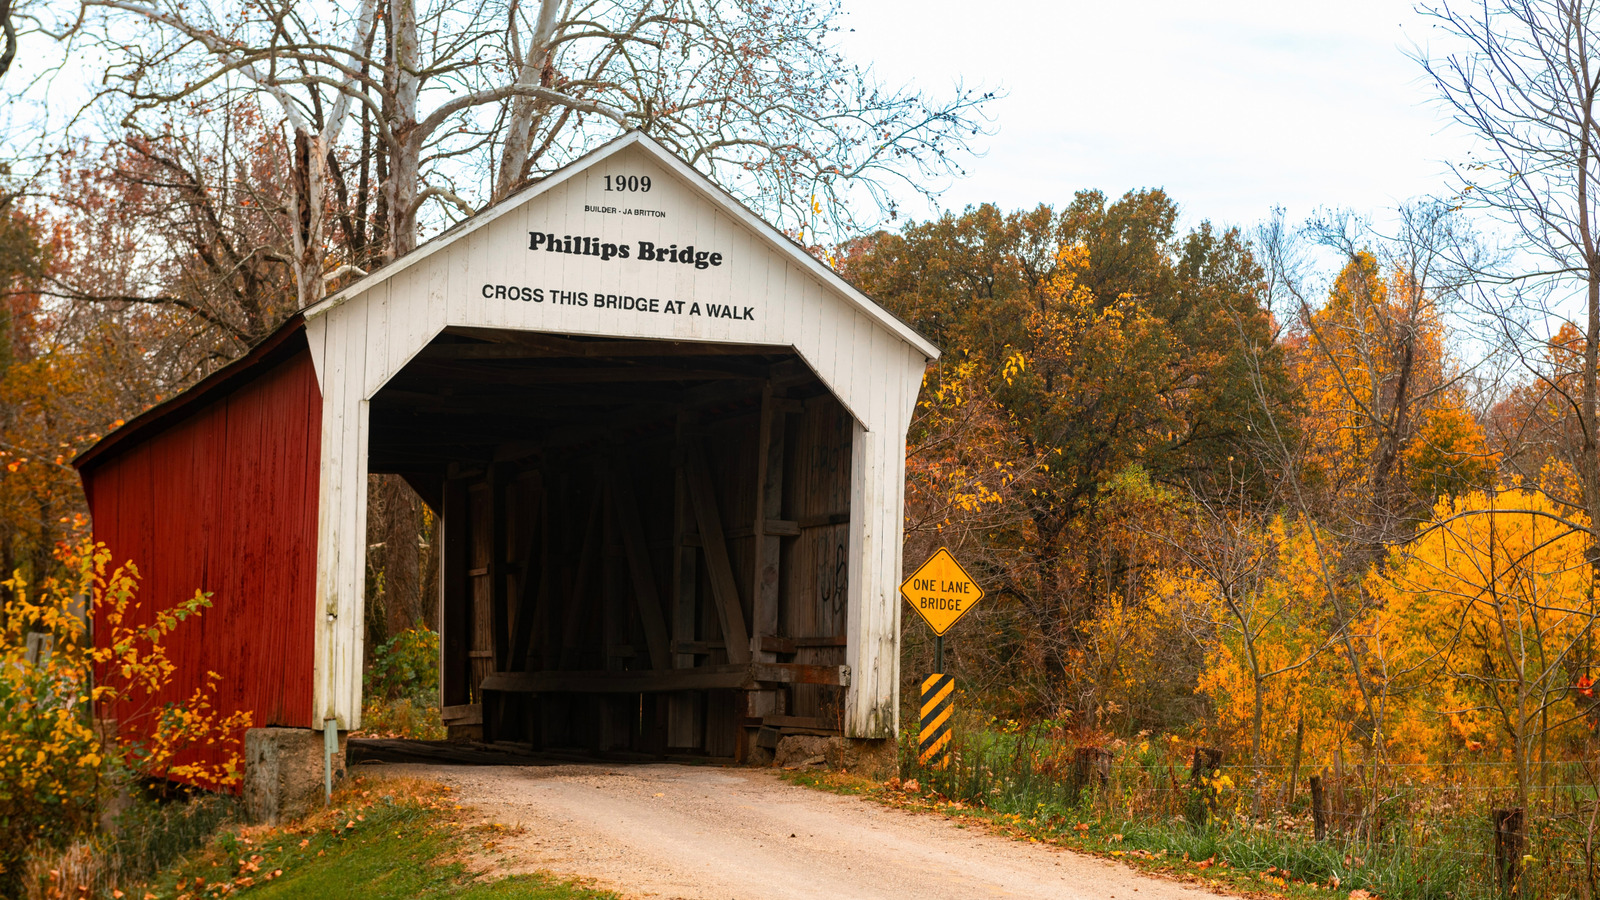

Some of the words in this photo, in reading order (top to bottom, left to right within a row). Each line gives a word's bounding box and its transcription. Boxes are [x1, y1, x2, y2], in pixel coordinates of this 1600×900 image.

[603, 174, 652, 193] 1909
[584, 204, 617, 214] BUILDER
[633, 208, 666, 218] BRITTON
[528, 231, 630, 261] Phillips
[637, 240, 723, 270] Bridge
[481, 284, 545, 303] CROSS
[549, 289, 589, 307] THIS
[593, 293, 660, 313] BRIDGE
[663, 300, 685, 315] AT
[689, 302, 702, 316] A
[705, 303, 755, 321] WALK
[913, 578, 937, 592] ONE
[941, 580, 971, 594] LANE
[920, 596, 962, 612] BRIDGE
